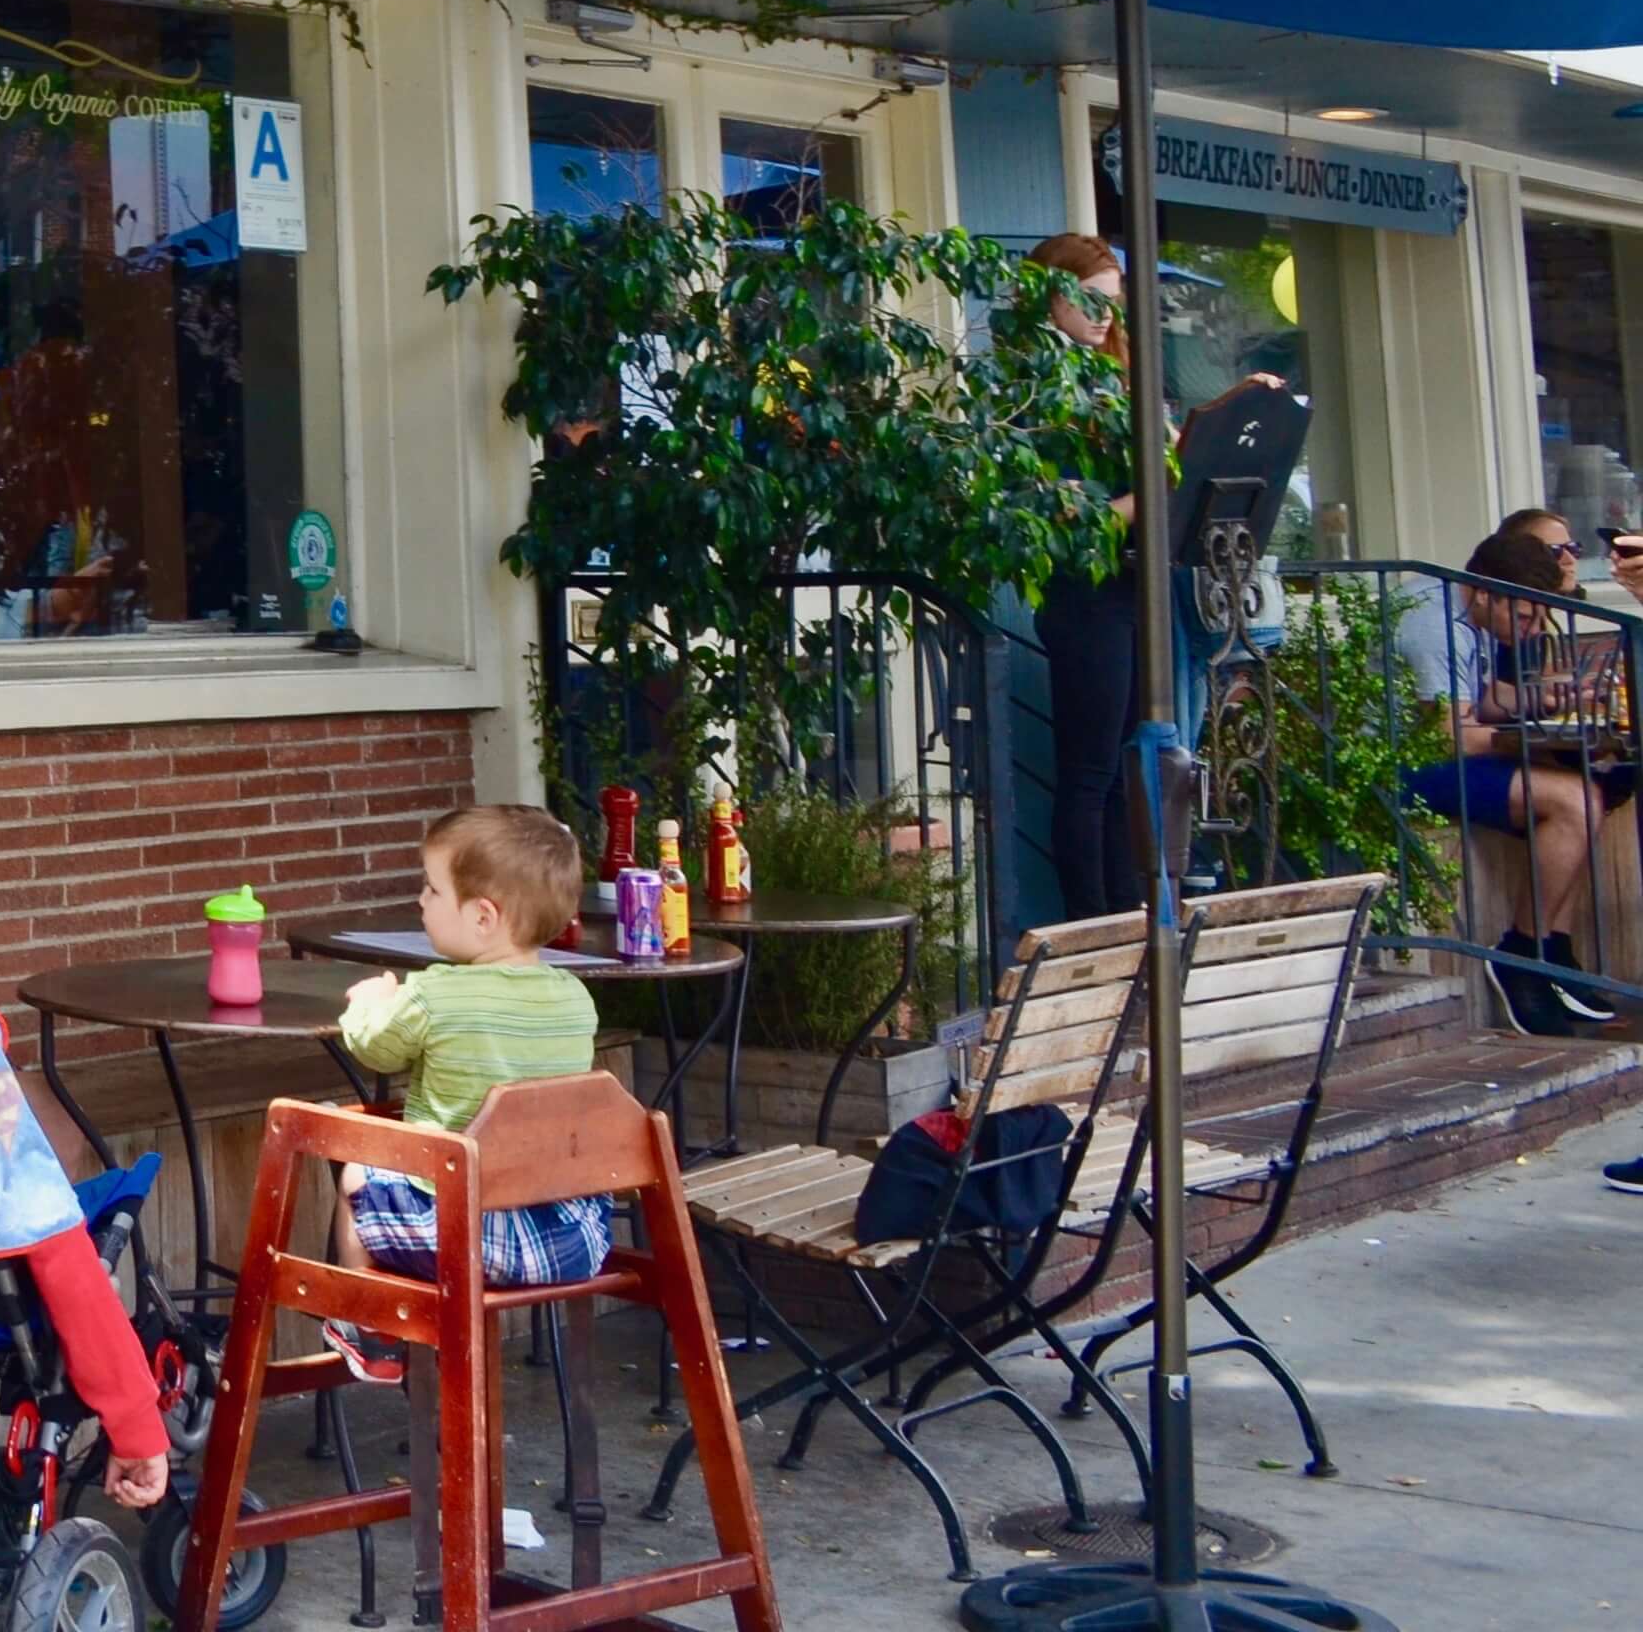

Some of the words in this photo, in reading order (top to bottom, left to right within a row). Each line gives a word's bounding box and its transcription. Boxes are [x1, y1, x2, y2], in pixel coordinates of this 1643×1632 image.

[29, 73, 116, 126] Organic
[123, 95, 202, 126] COFFEE
[250, 111, 290, 182] A
[1155, 134, 1276, 191] BREAKFAST
[1283, 155, 1351, 202] LUNCH
[1357, 164, 1428, 212] DINNER
